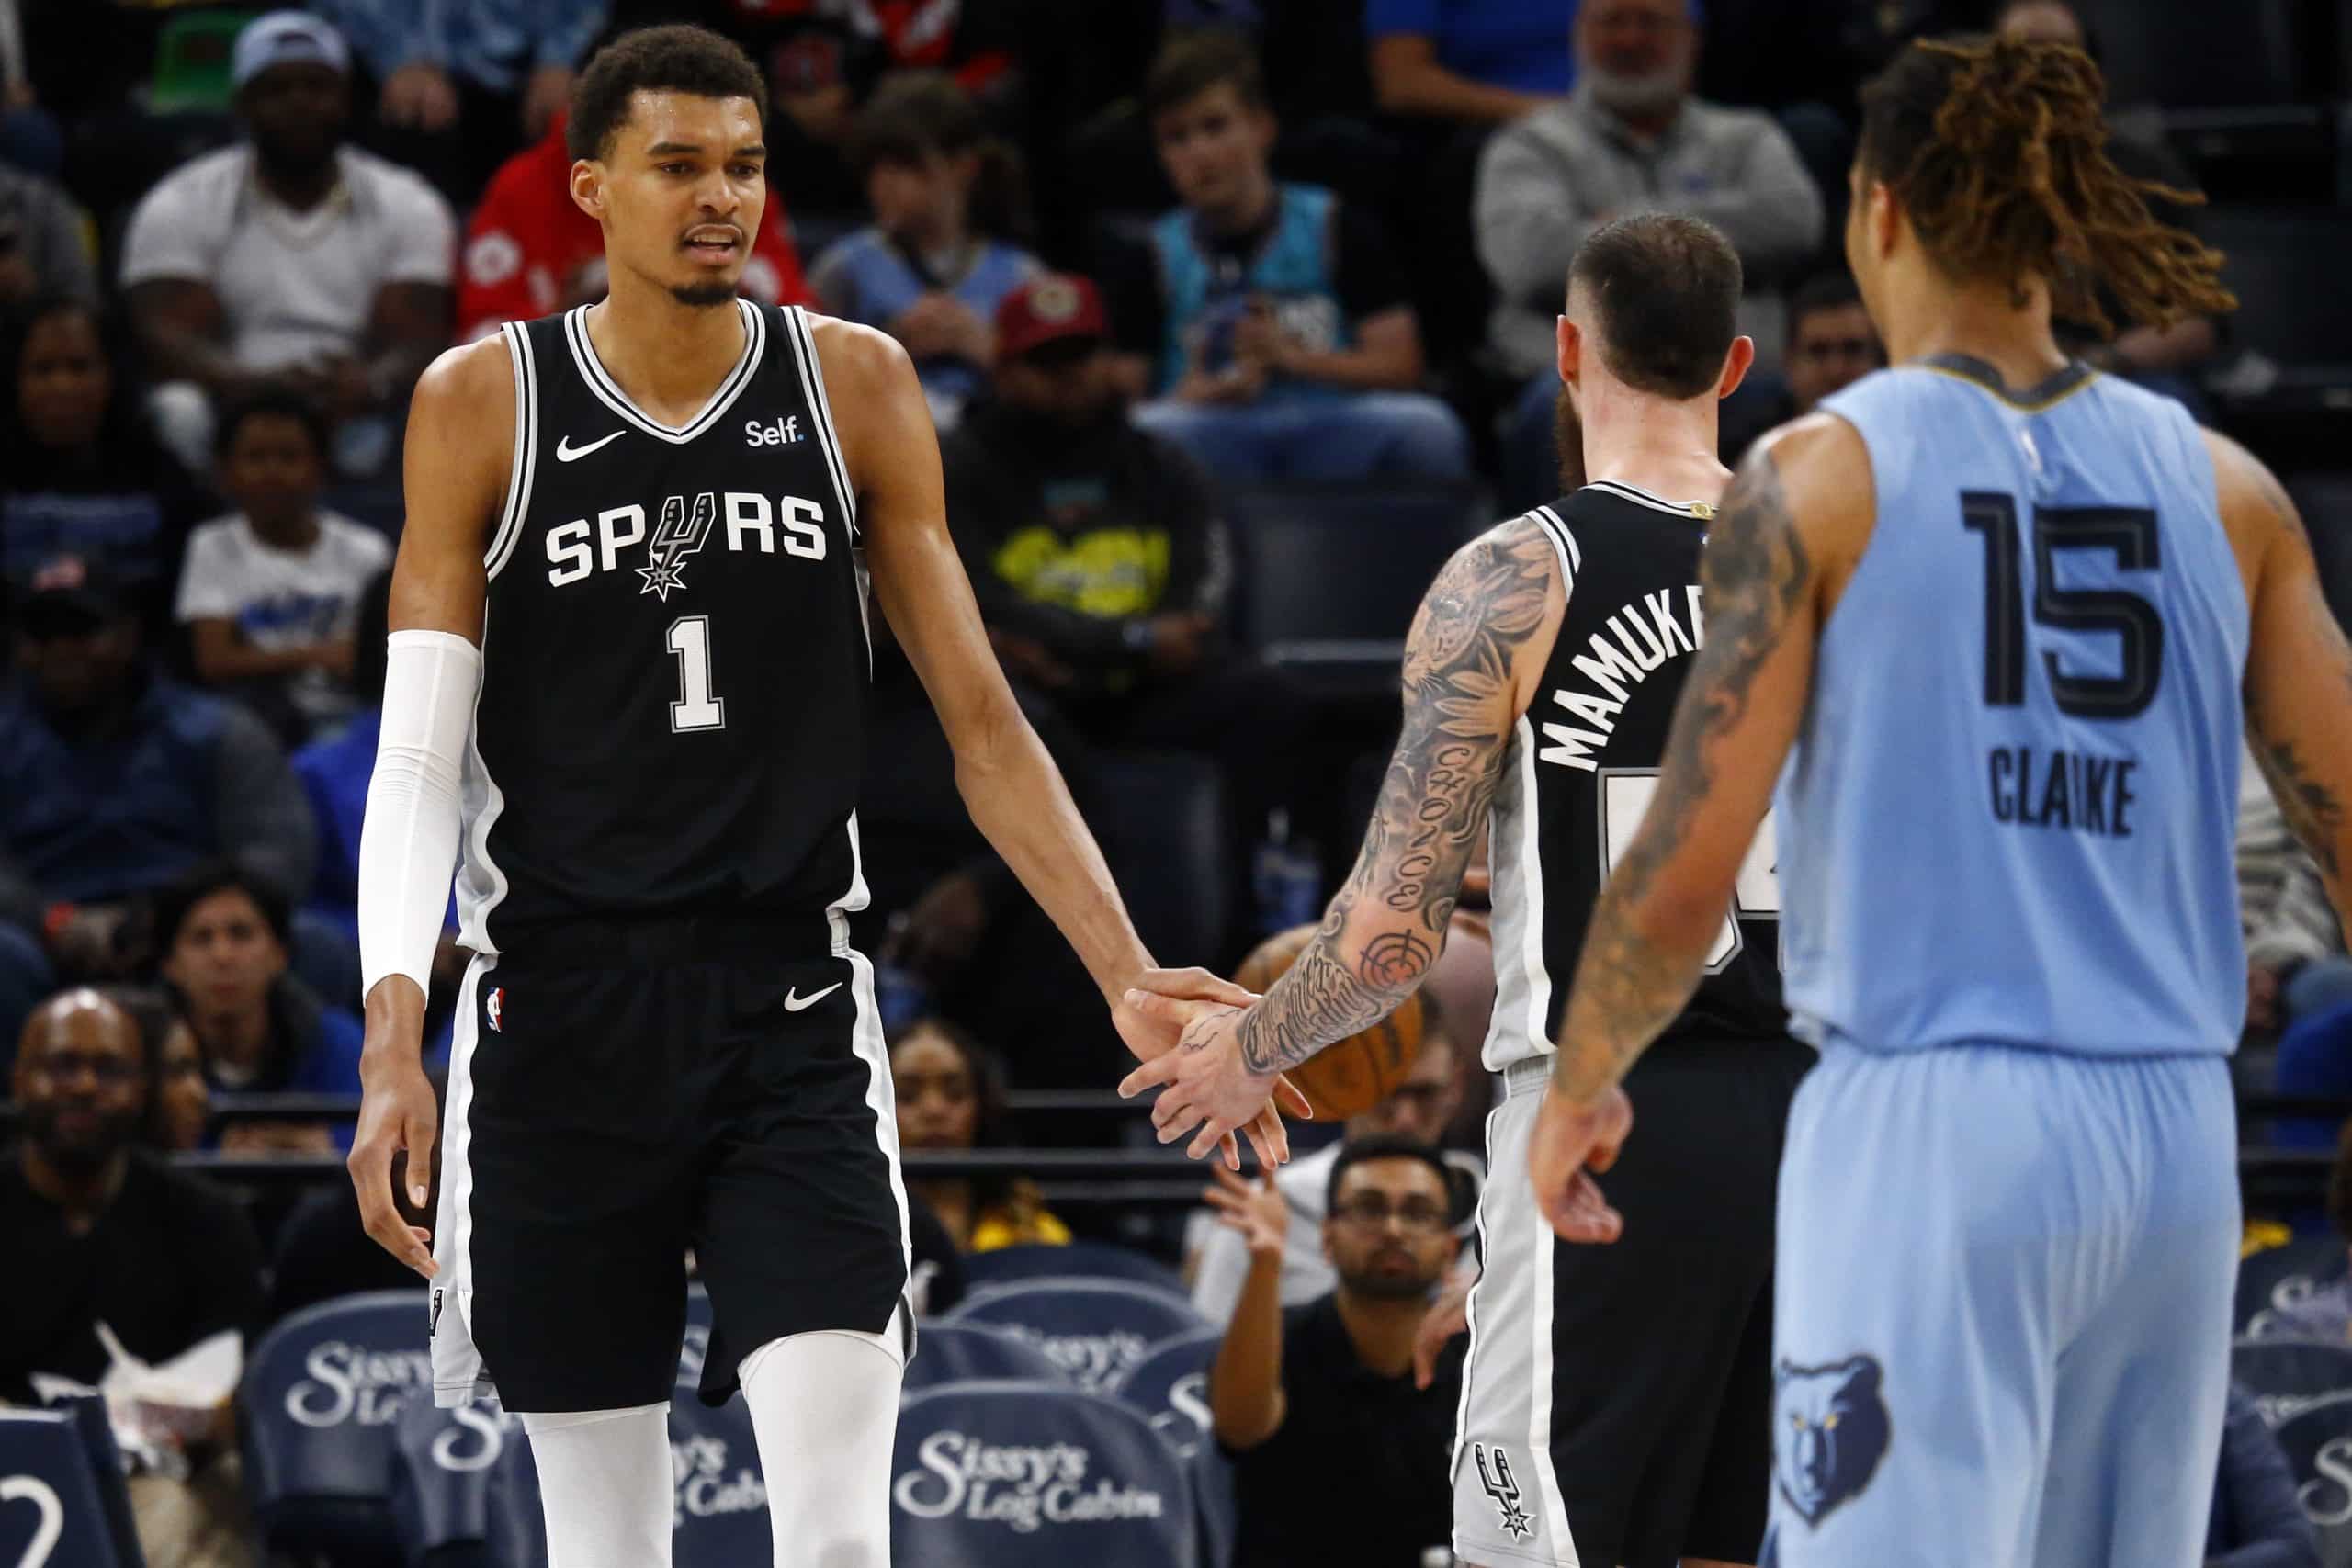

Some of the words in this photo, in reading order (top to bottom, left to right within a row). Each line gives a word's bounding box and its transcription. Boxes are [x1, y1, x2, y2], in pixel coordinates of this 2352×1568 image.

[546, 492, 826, 603] SPURS
[1959, 488, 2165, 723] 15
[665, 615, 726, 734] 1
